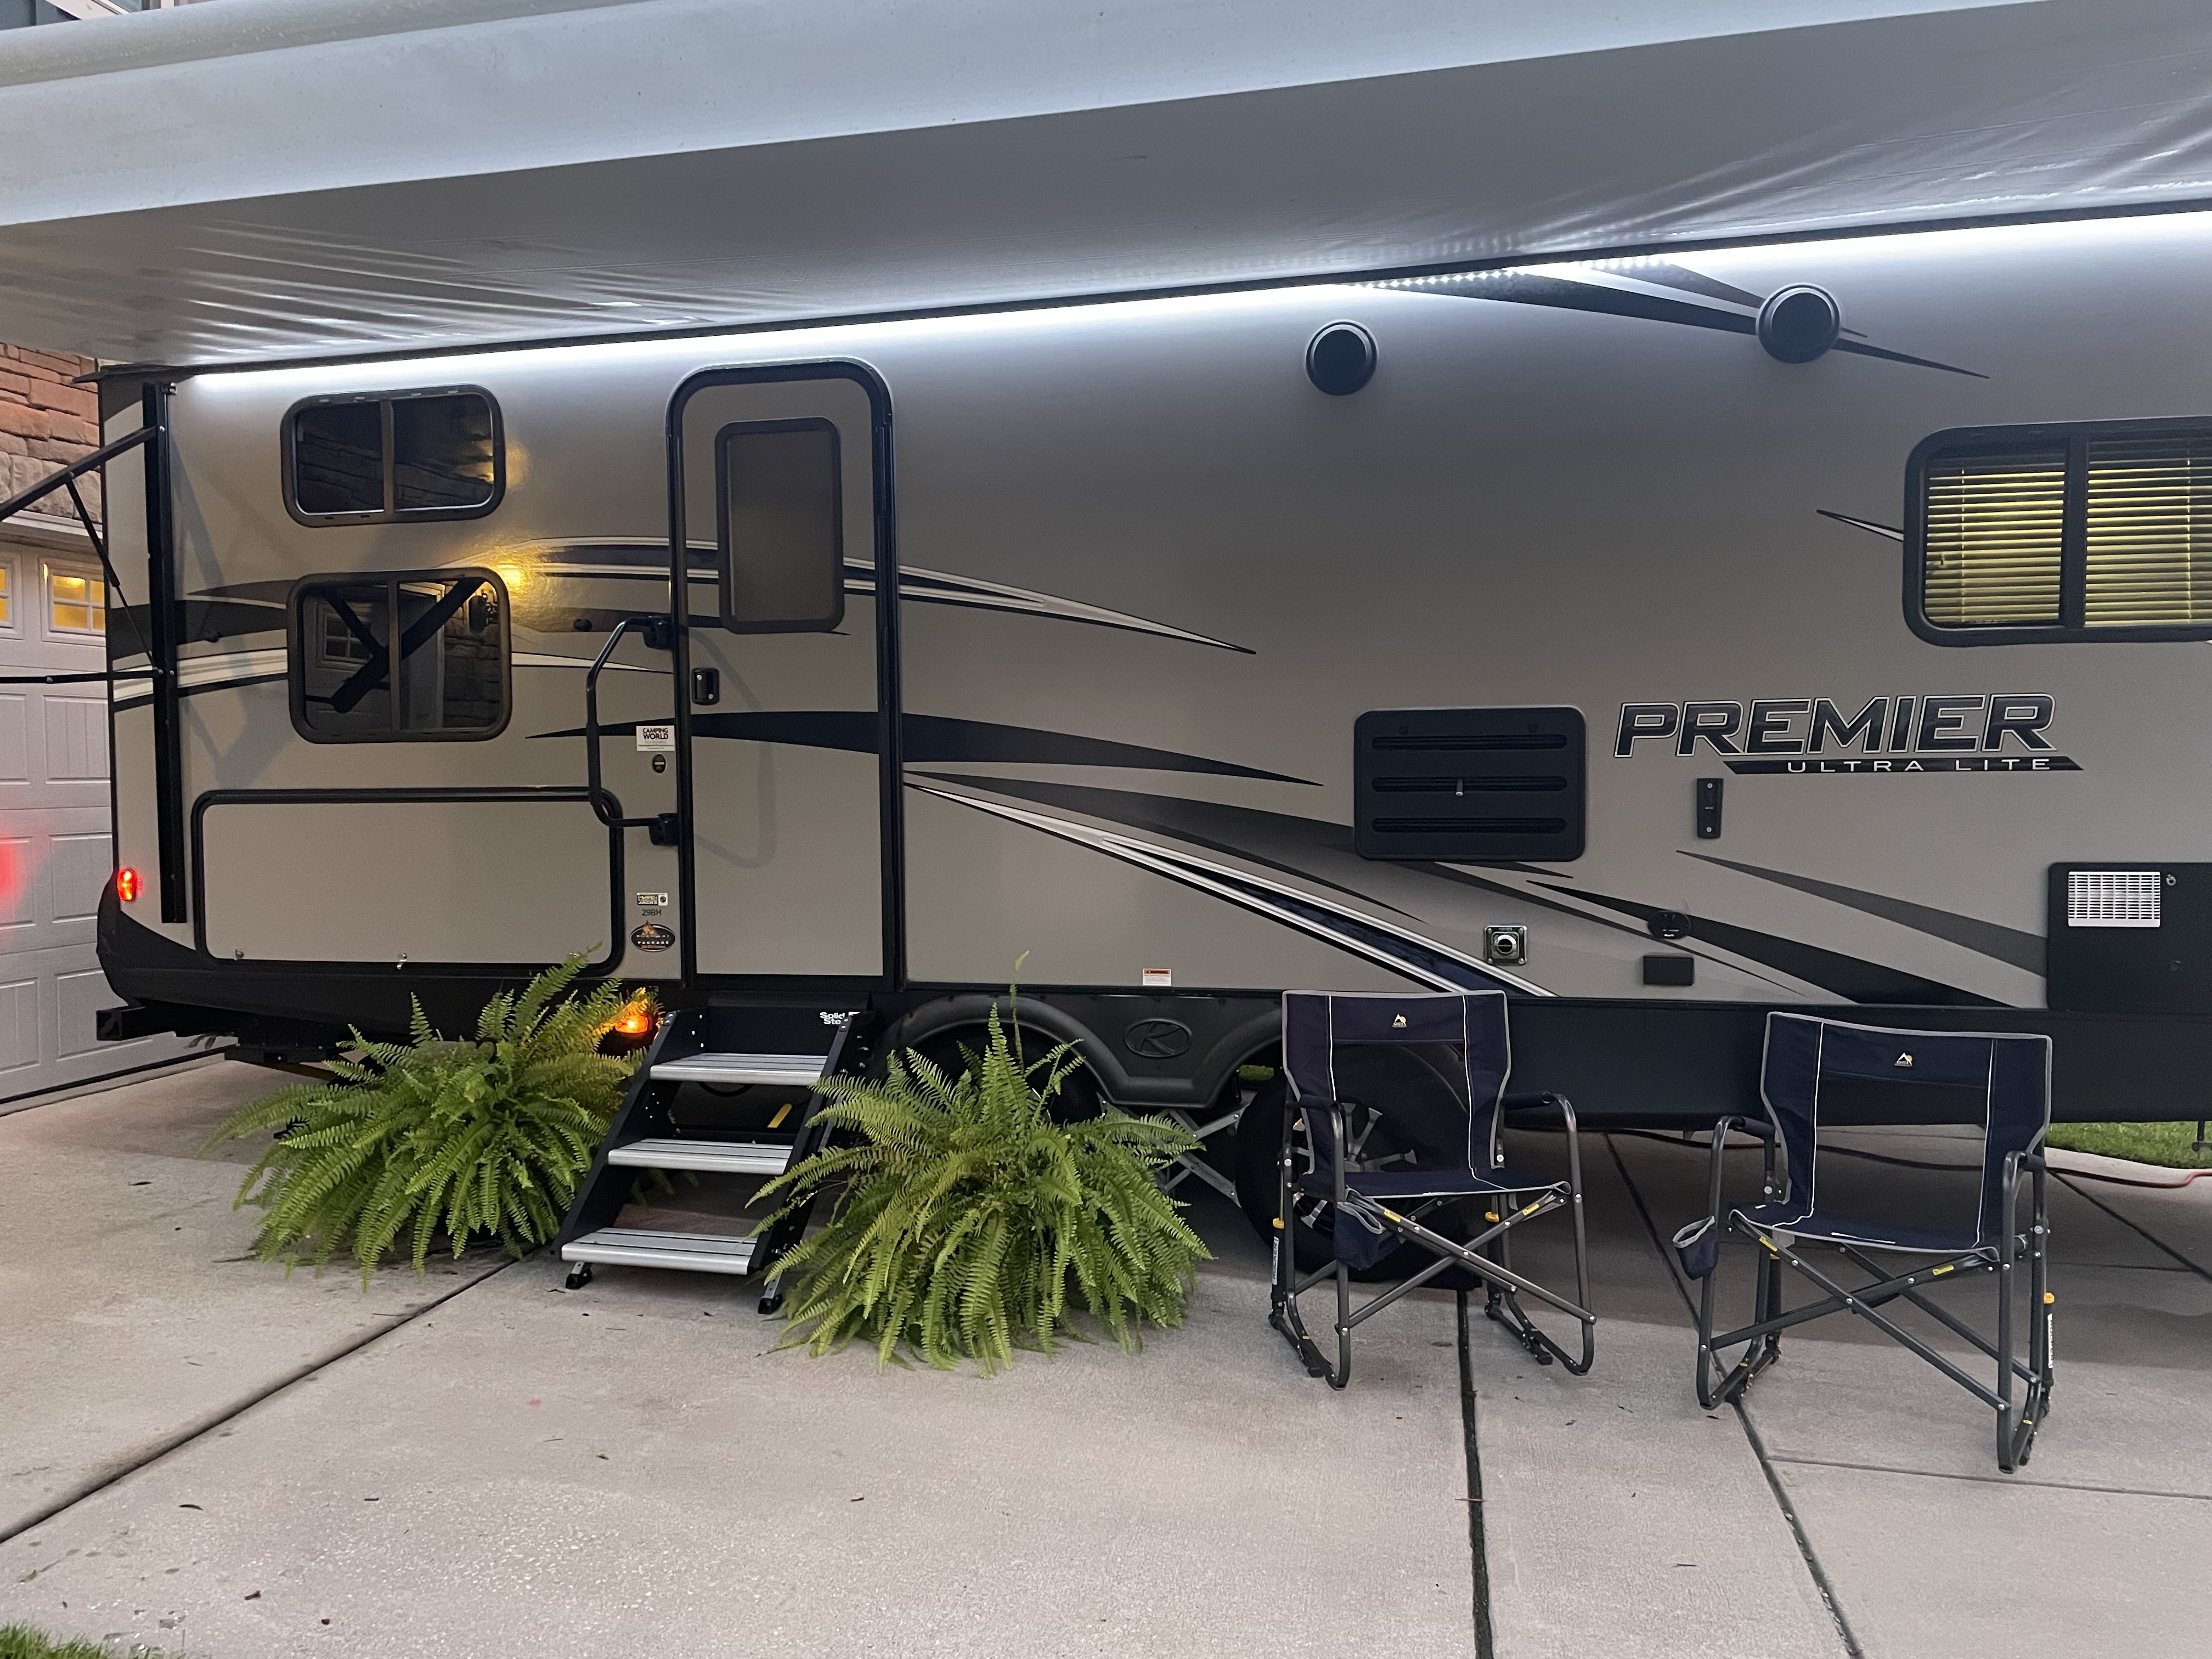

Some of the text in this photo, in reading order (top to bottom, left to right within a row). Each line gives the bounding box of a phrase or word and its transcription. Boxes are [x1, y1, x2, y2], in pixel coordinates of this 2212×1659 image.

[1614, 692, 2058, 758] PREMIER
[1787, 758, 2051, 773] ULTRA LITE
